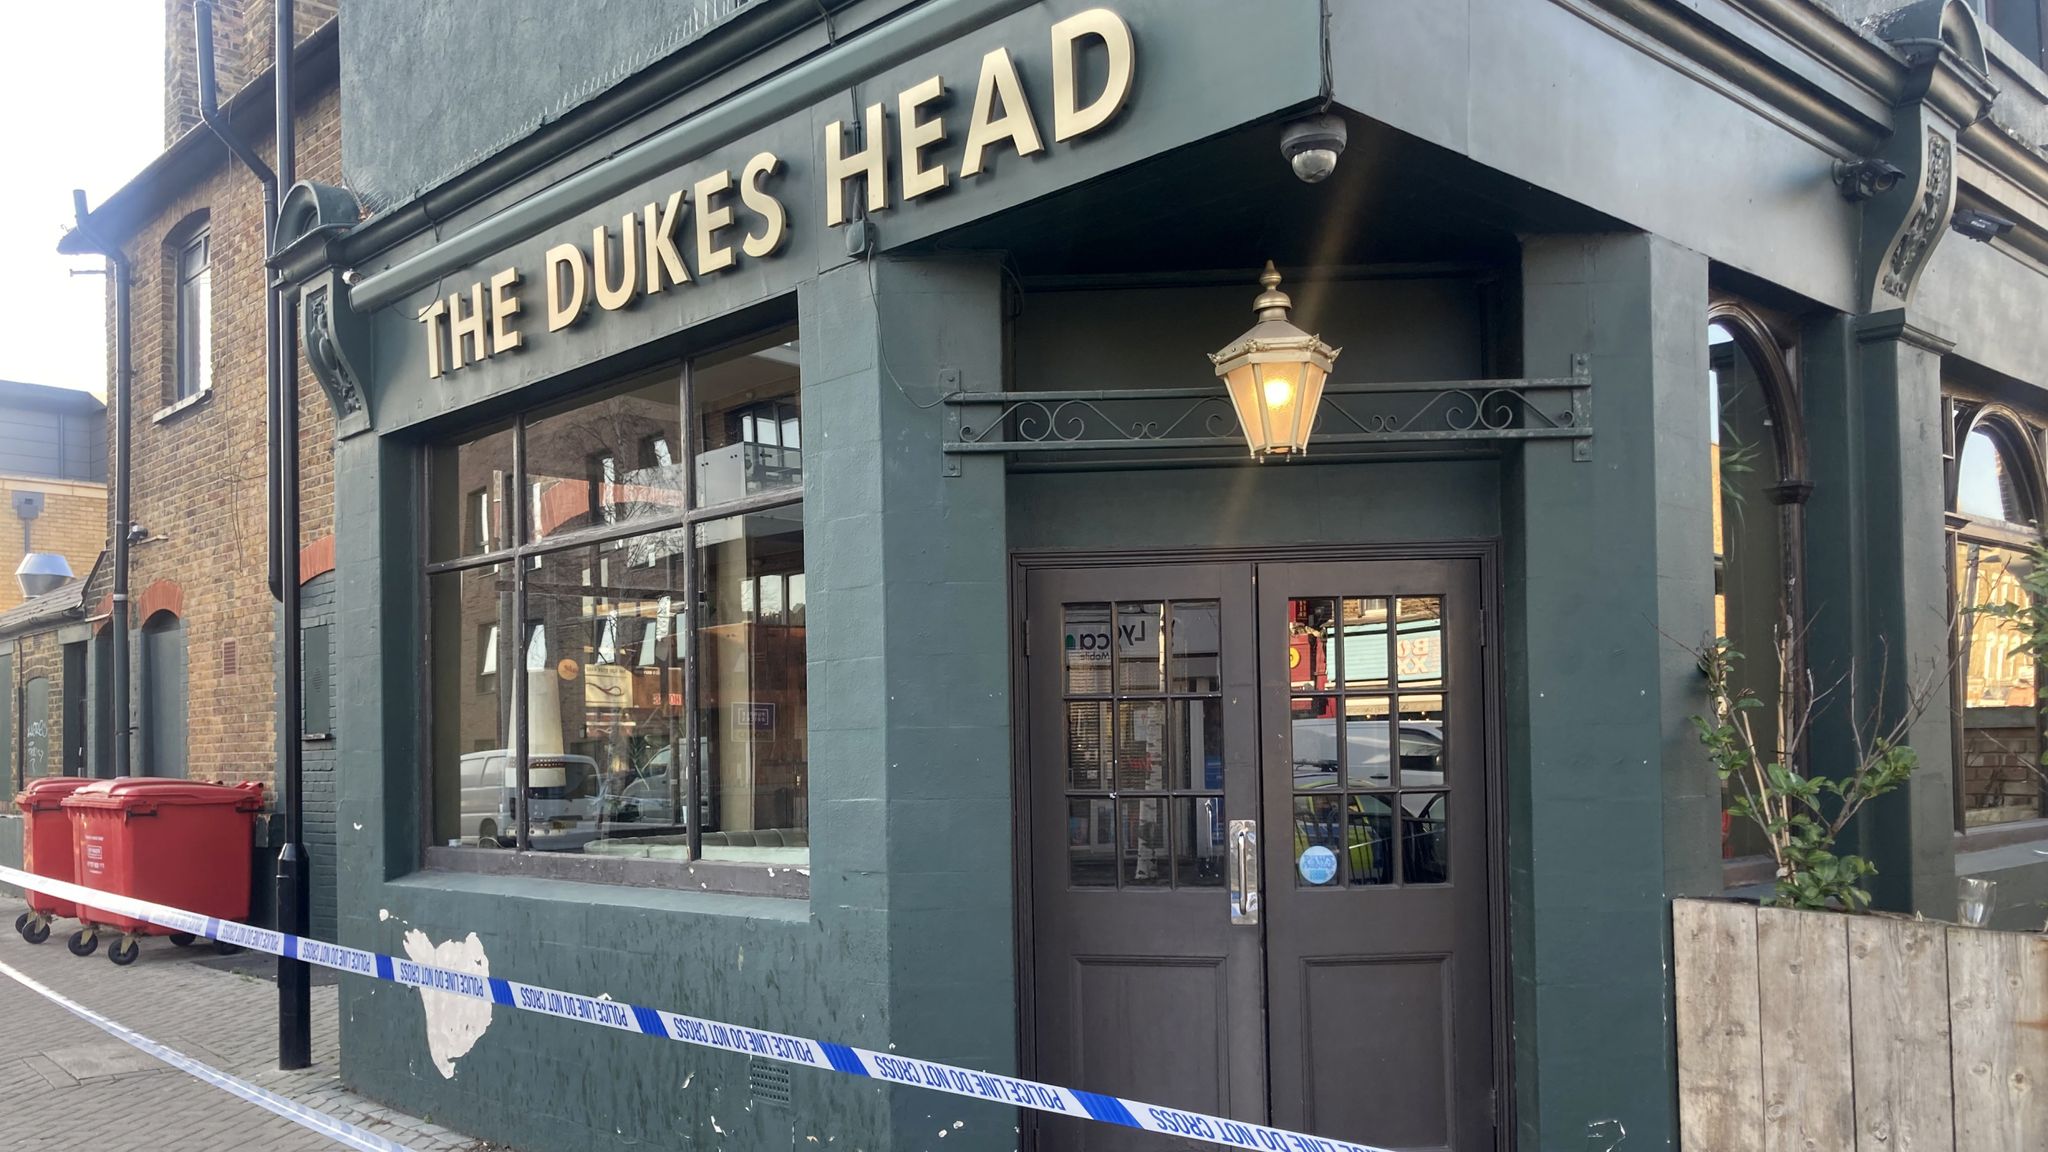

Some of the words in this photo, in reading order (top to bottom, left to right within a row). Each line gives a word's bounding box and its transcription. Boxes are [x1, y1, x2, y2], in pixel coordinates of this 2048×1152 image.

[418, 267, 522, 379] THE
[545, 151, 787, 333] DUKES
[825, 7, 1135, 227] HEAD
[302, 941, 320, 960] CROSS
[319, 945, 331, 962] NOT
[330, 947, 340, 964] DO
[338, 949, 351, 967] LINE
[350, 952, 371, 972] POLICE
[400, 962, 421, 983] CROSS
[421, 967, 434, 986] NOT
[434, 969, 445, 988] DO
[444, 971, 460, 992] LINE
[459, 974, 485, 997] POLICE
[521, 987, 546, 1009] CROSS
[547, 992, 563, 1013] NOT
[564, 996, 577, 1017] DO
[576, 998, 597, 1020] LINE
[596, 1002, 628, 1027] POLICE
[673, 1017, 709, 1043] CROSS
[709, 1024, 730, 1046] NOT
[731, 1027, 748, 1051] DO
[745, 1031, 774, 1055] LINE
[771, 1036, 815, 1063] POLICE
[874, 1055, 921, 1084] CROSS
[922, 1063, 950, 1088] NOT
[949, 1069, 972, 1094] DO
[972, 1074, 1010, 1101] LINE
[1006, 1081, 1065, 1111] POLICE
[1150, 1108, 1215, 1138] CROSS
[1215, 1120, 1256, 1147] NOT
[1257, 1128, 1287, 1152] DO
